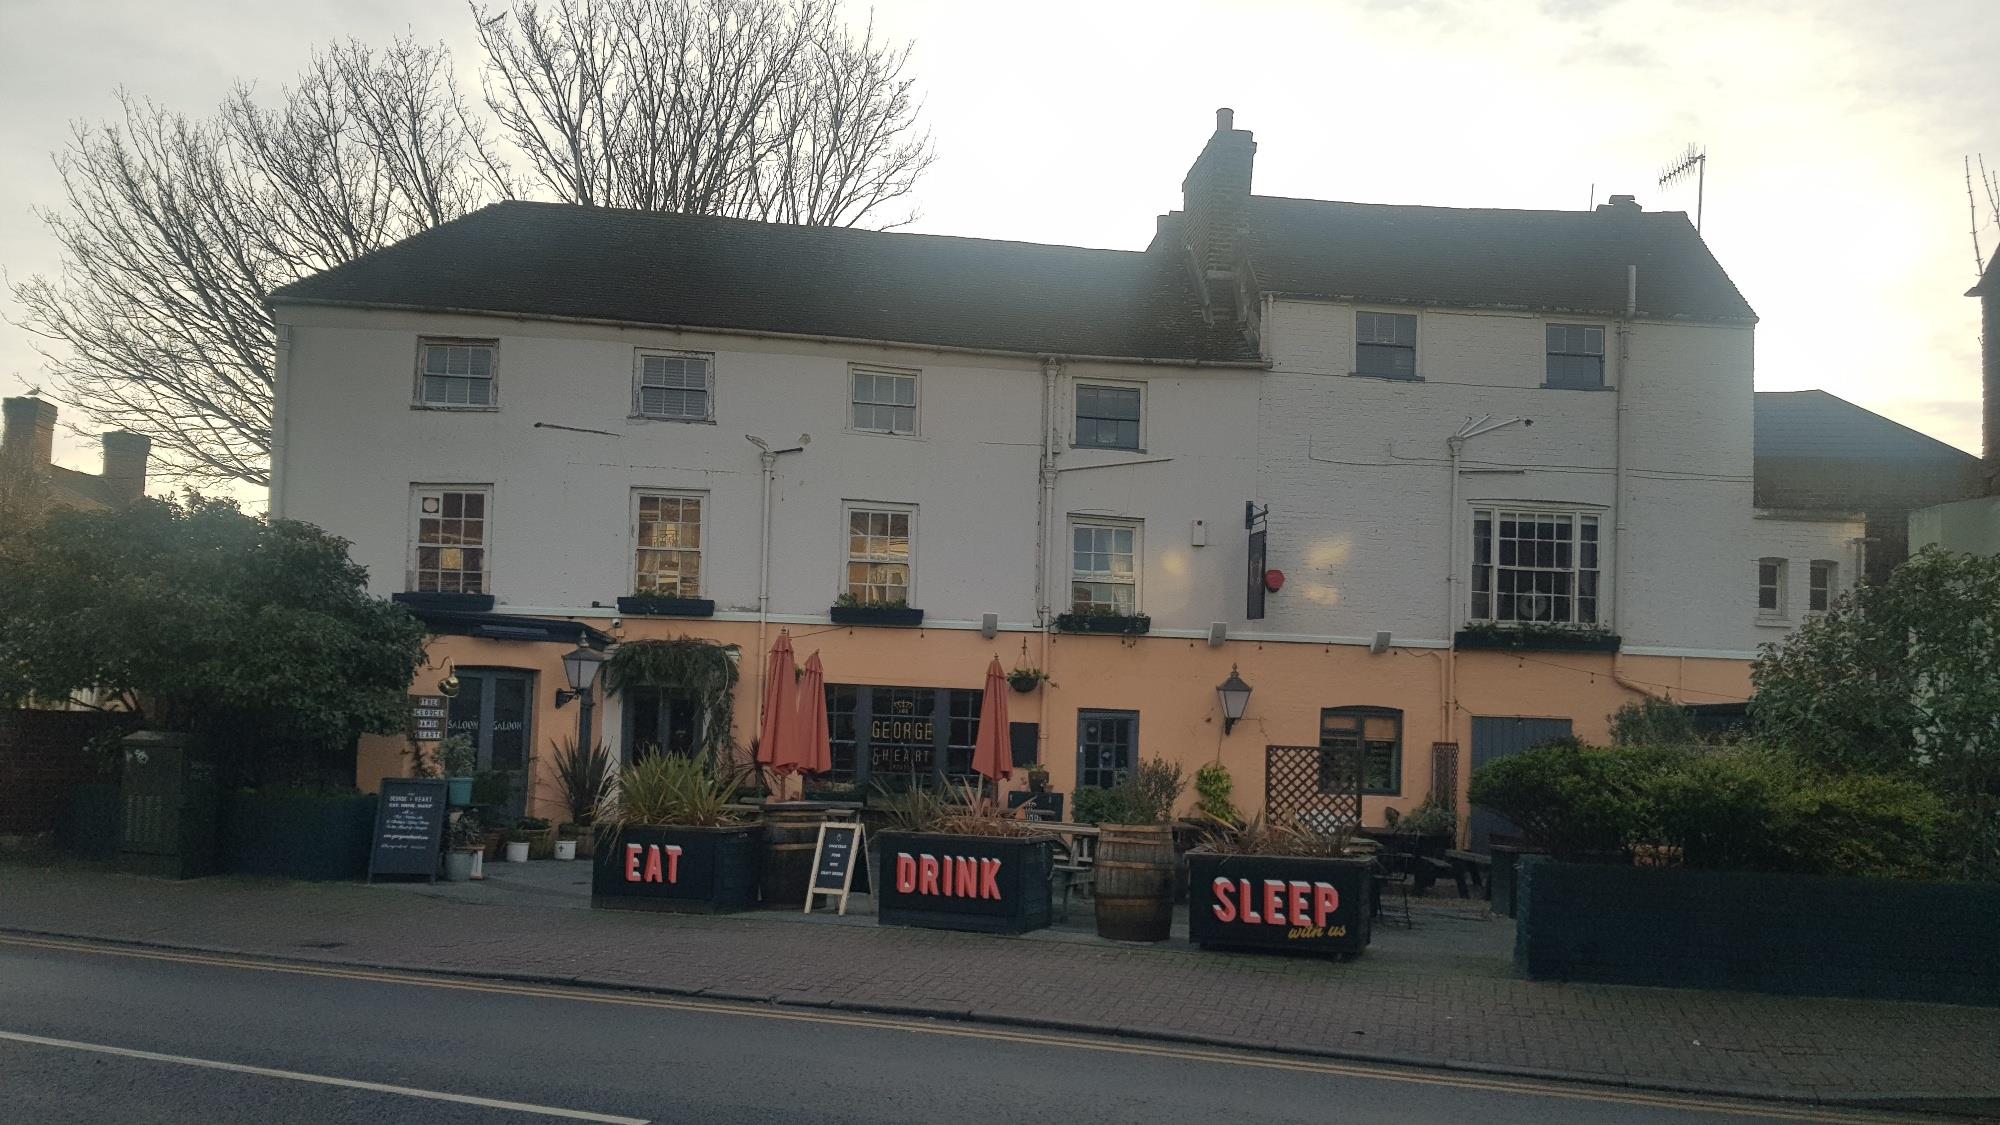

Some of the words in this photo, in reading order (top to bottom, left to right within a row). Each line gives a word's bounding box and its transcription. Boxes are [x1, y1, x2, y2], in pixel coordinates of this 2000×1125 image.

[447, 720, 480, 730] SALOON
[493, 720, 522, 730] SALOON
[872, 720, 933, 740] GEORGE
[626, 843, 683, 883] EAT
[896, 852, 1002, 901] DRINK
[1212, 876, 1339, 927] SLEEP
[1288, 924, 1325, 939] with
[1327, 924, 1346, 937] us
